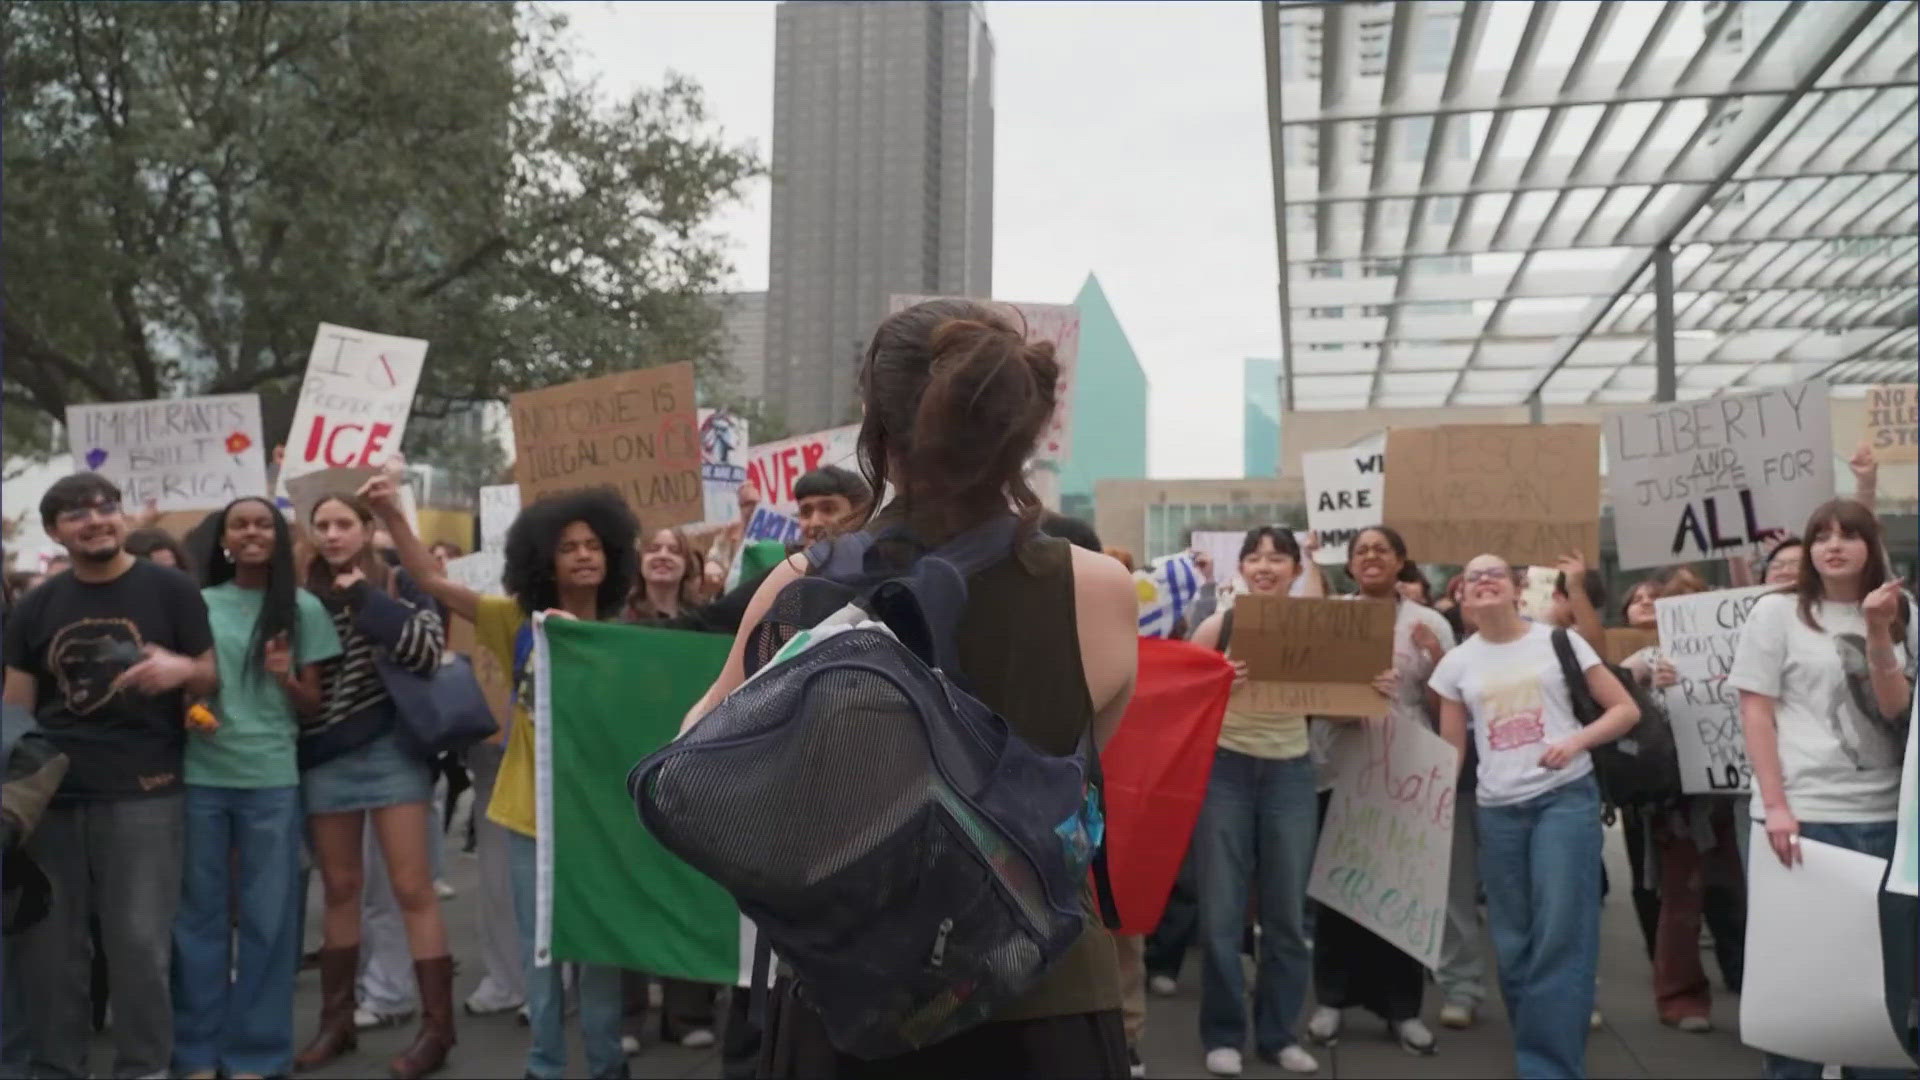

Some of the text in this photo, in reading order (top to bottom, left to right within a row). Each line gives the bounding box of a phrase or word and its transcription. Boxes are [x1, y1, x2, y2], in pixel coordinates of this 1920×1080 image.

[327, 333, 363, 377] I
[518, 382, 676, 440] NO ONE IS
[1873, 389, 1905, 408] NO
[85, 402, 246, 444] IMMIGRANTS
[304, 416, 393, 468] ICE
[1617, 384, 1808, 462] LIBERTY
[526, 438, 610, 484] ILLEGAL
[612, 433, 655, 464] ON
[1403, 432, 1576, 478] JESUS
[1635, 448, 1815, 507] JUSTICE FOR
[117, 474, 237, 506] MERICA
[634, 469, 699, 509] LAND
[1318, 490, 1372, 512] ARE
[1672, 487, 1785, 556] ALL
